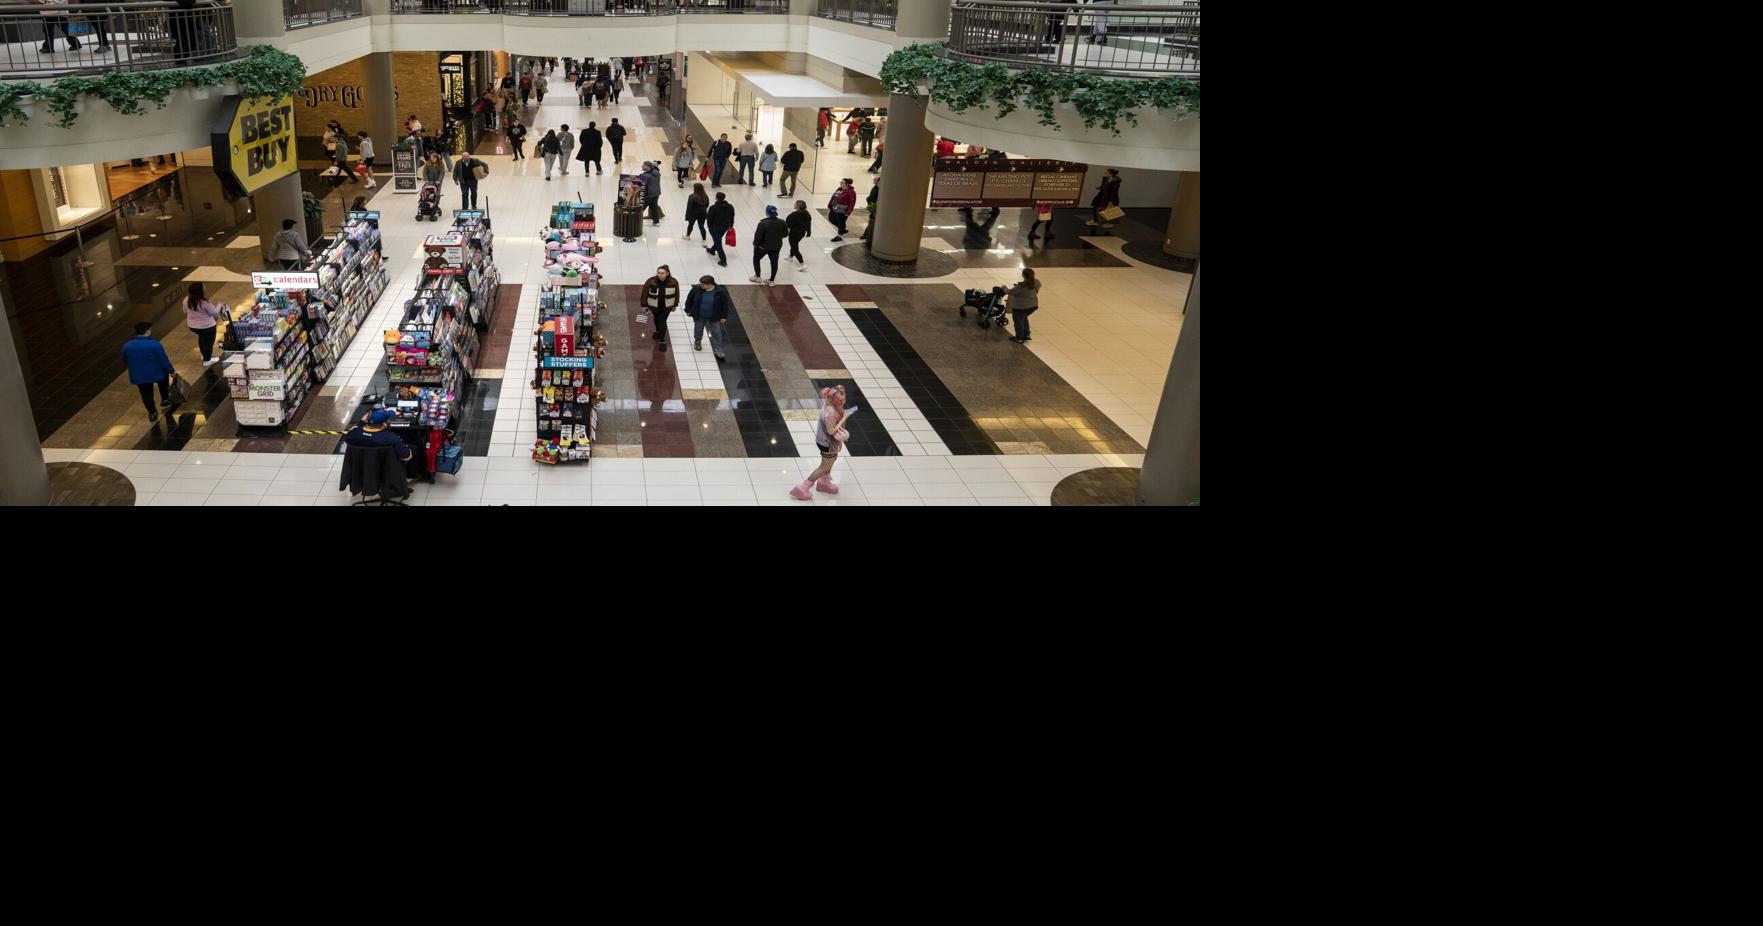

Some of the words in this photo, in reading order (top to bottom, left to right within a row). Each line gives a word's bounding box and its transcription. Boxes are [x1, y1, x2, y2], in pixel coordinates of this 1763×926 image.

[298, 86, 338, 108] DRY
[240, 105, 291, 145] BEST
[247, 135, 291, 177] BUY
[273, 276, 318, 284] calendars
